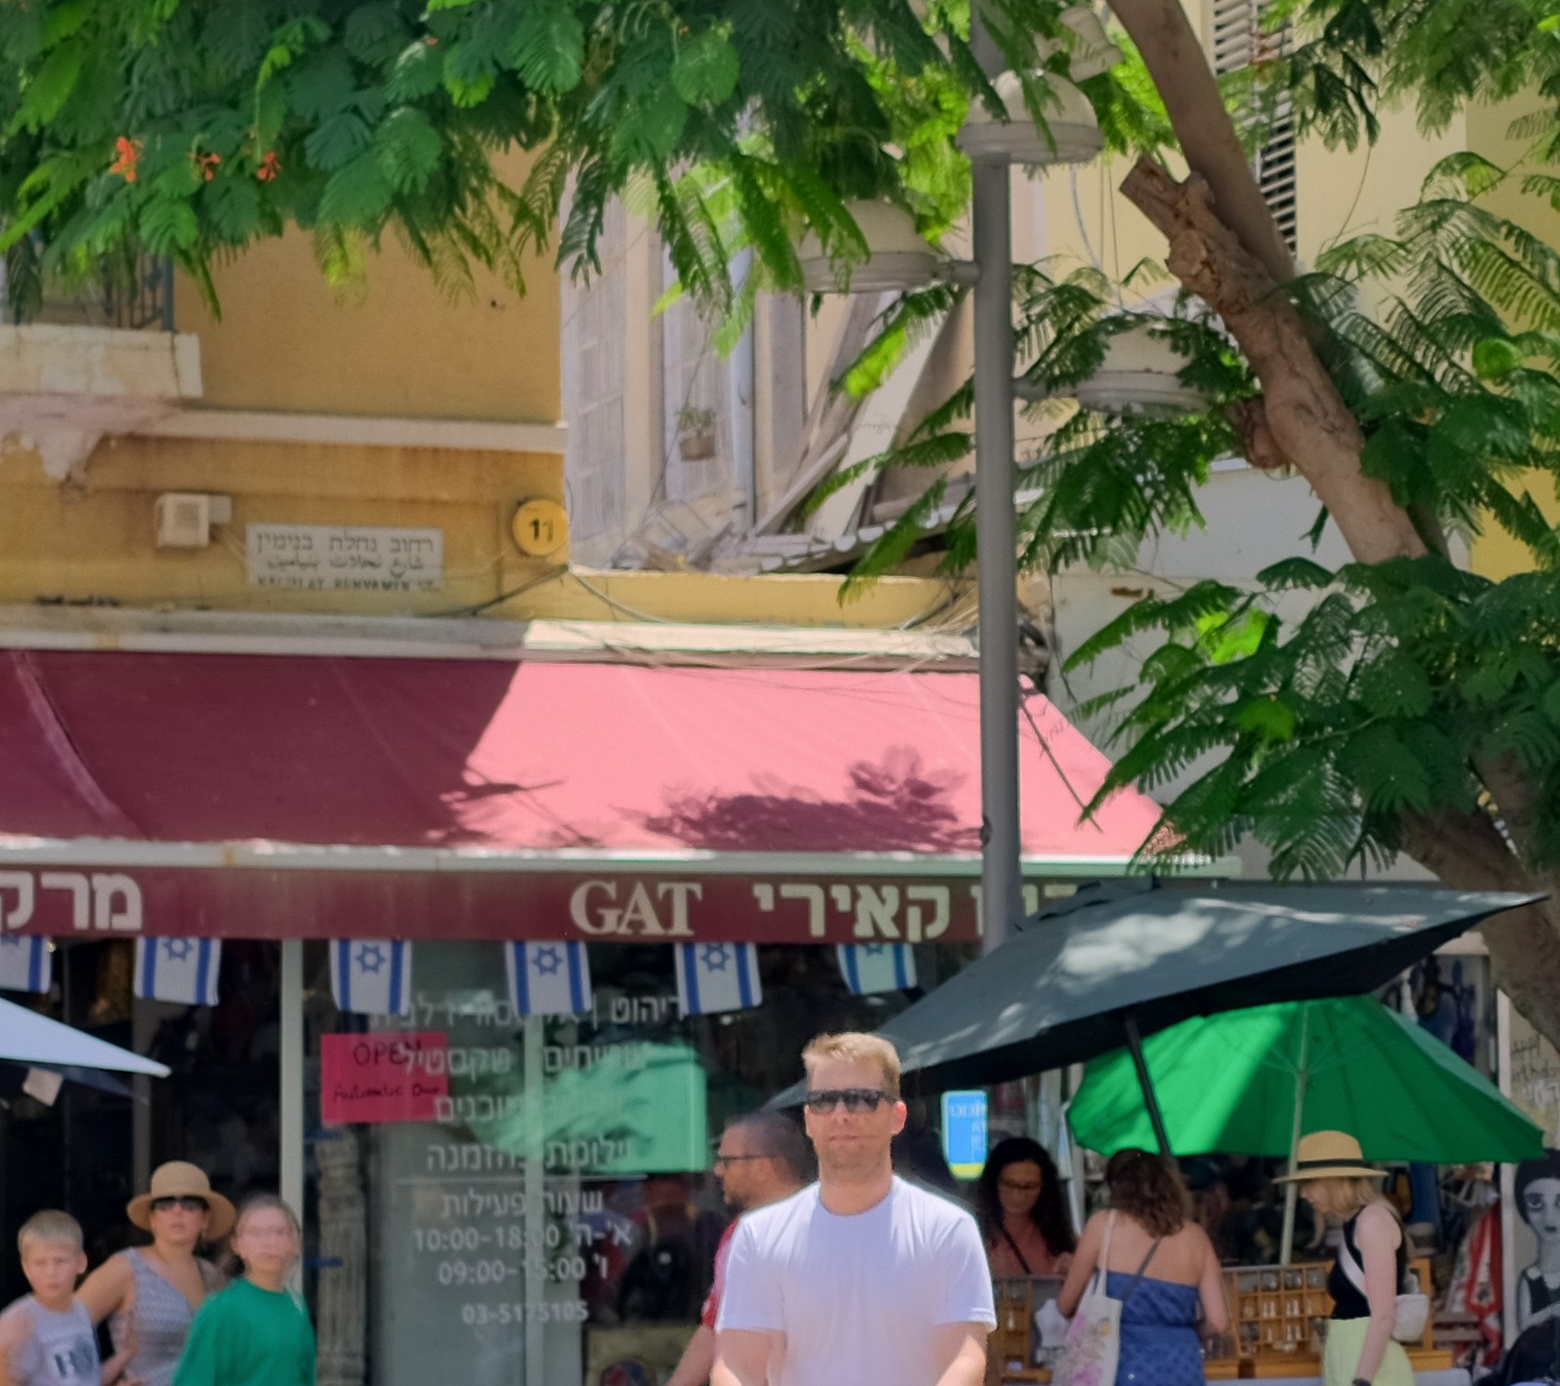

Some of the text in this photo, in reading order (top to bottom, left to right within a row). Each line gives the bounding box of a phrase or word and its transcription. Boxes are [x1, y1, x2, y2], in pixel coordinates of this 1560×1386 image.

[256, 527, 434, 554] רחוב נחלת בנימין
[569, 880, 703, 936] GAT
[753, 883, 951, 943] קאירי
